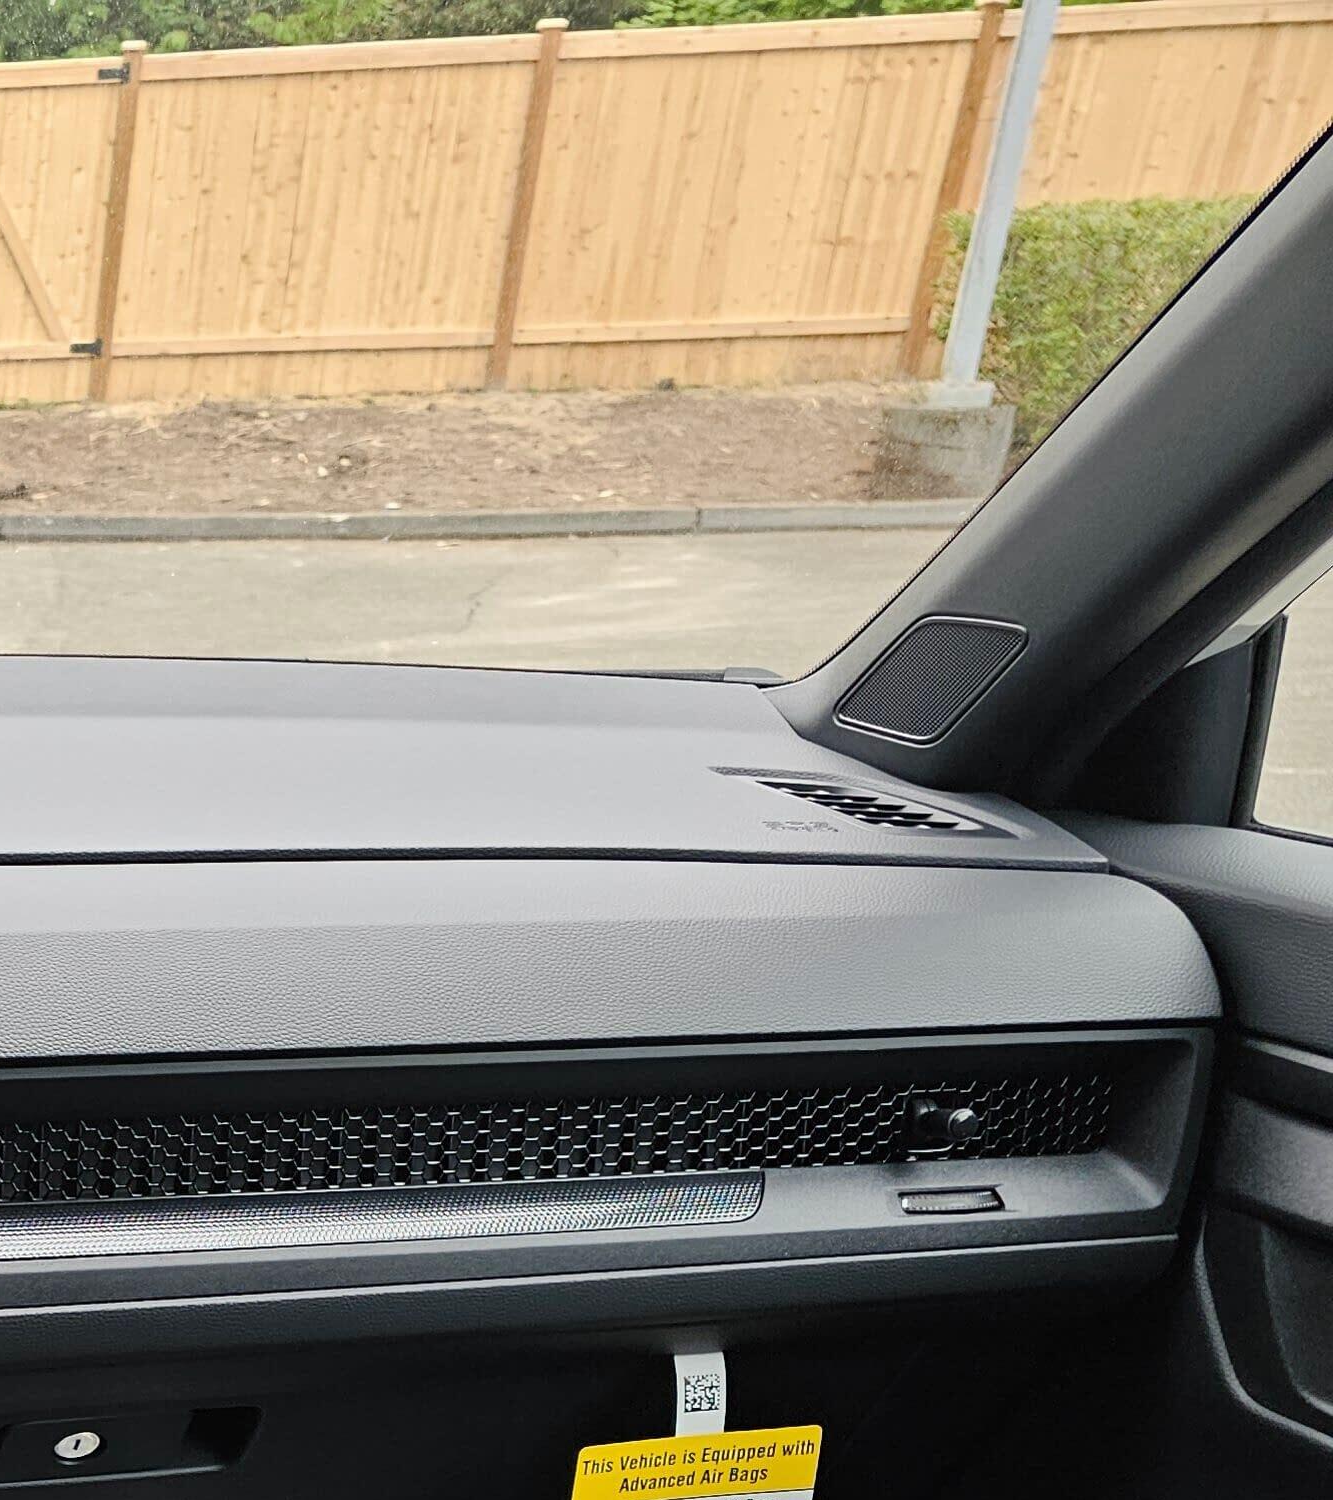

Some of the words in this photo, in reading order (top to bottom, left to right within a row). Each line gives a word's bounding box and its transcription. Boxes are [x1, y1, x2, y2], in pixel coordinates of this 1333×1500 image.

[582, 1458, 614, 1476] This
[620, 1451, 676, 1471] Vehicle
[682, 1450, 696, 1464] is
[701, 1442, 777, 1464] Equipped
[782, 1440, 815, 1456] with
[619, 1470, 695, 1493] Advanced
[700, 1469, 724, 1484] Air
[729, 1467, 769, 1484] Bags
